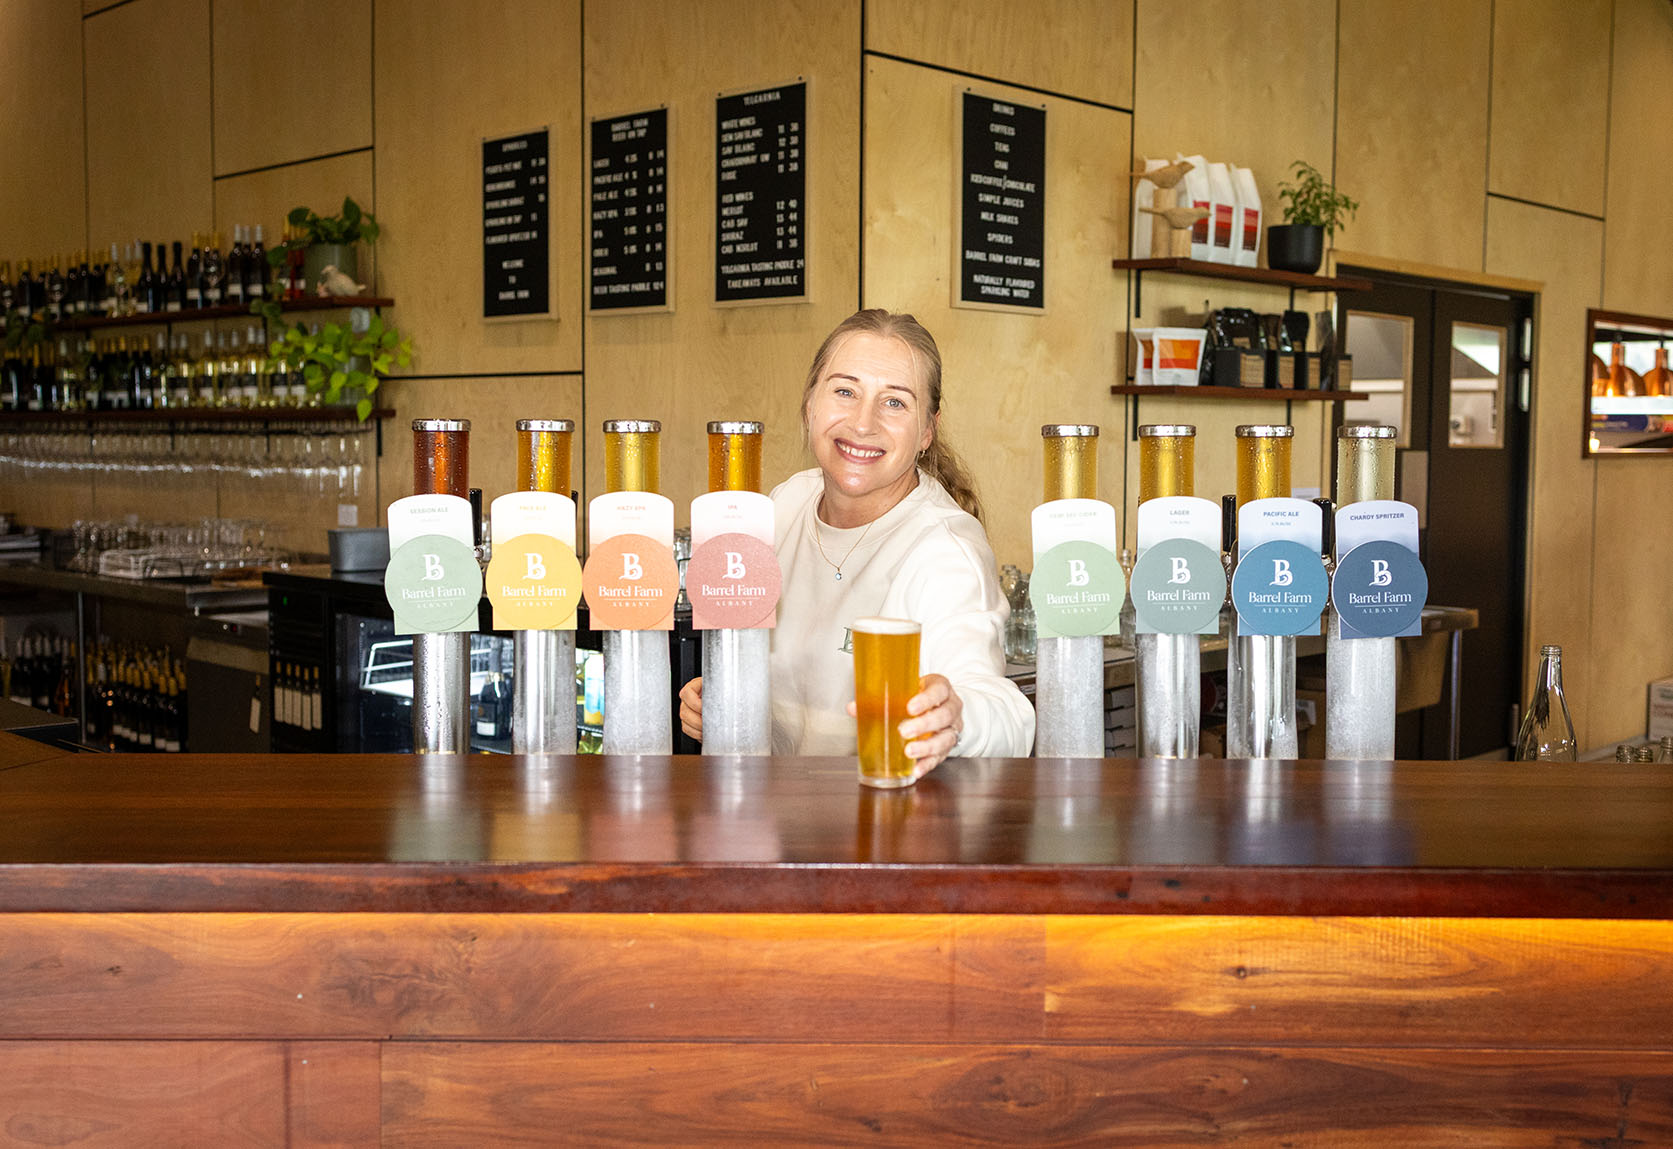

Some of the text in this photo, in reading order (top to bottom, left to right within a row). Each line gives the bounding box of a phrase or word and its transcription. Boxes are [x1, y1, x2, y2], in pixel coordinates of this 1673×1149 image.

[402, 586, 466, 599] Barrel Farm
[502, 586, 566, 597] Barrel Farm
[599, 586, 662, 597] Barrel Farm
[702, 585, 765, 596] Barrel Farm
[1147, 590, 1210, 601] Barrel Farm
[1047, 591, 1110, 605] Barrel Farm
[1249, 592, 1312, 603] Barrel Farm
[1349, 592, 1411, 605] Barrel Farm
